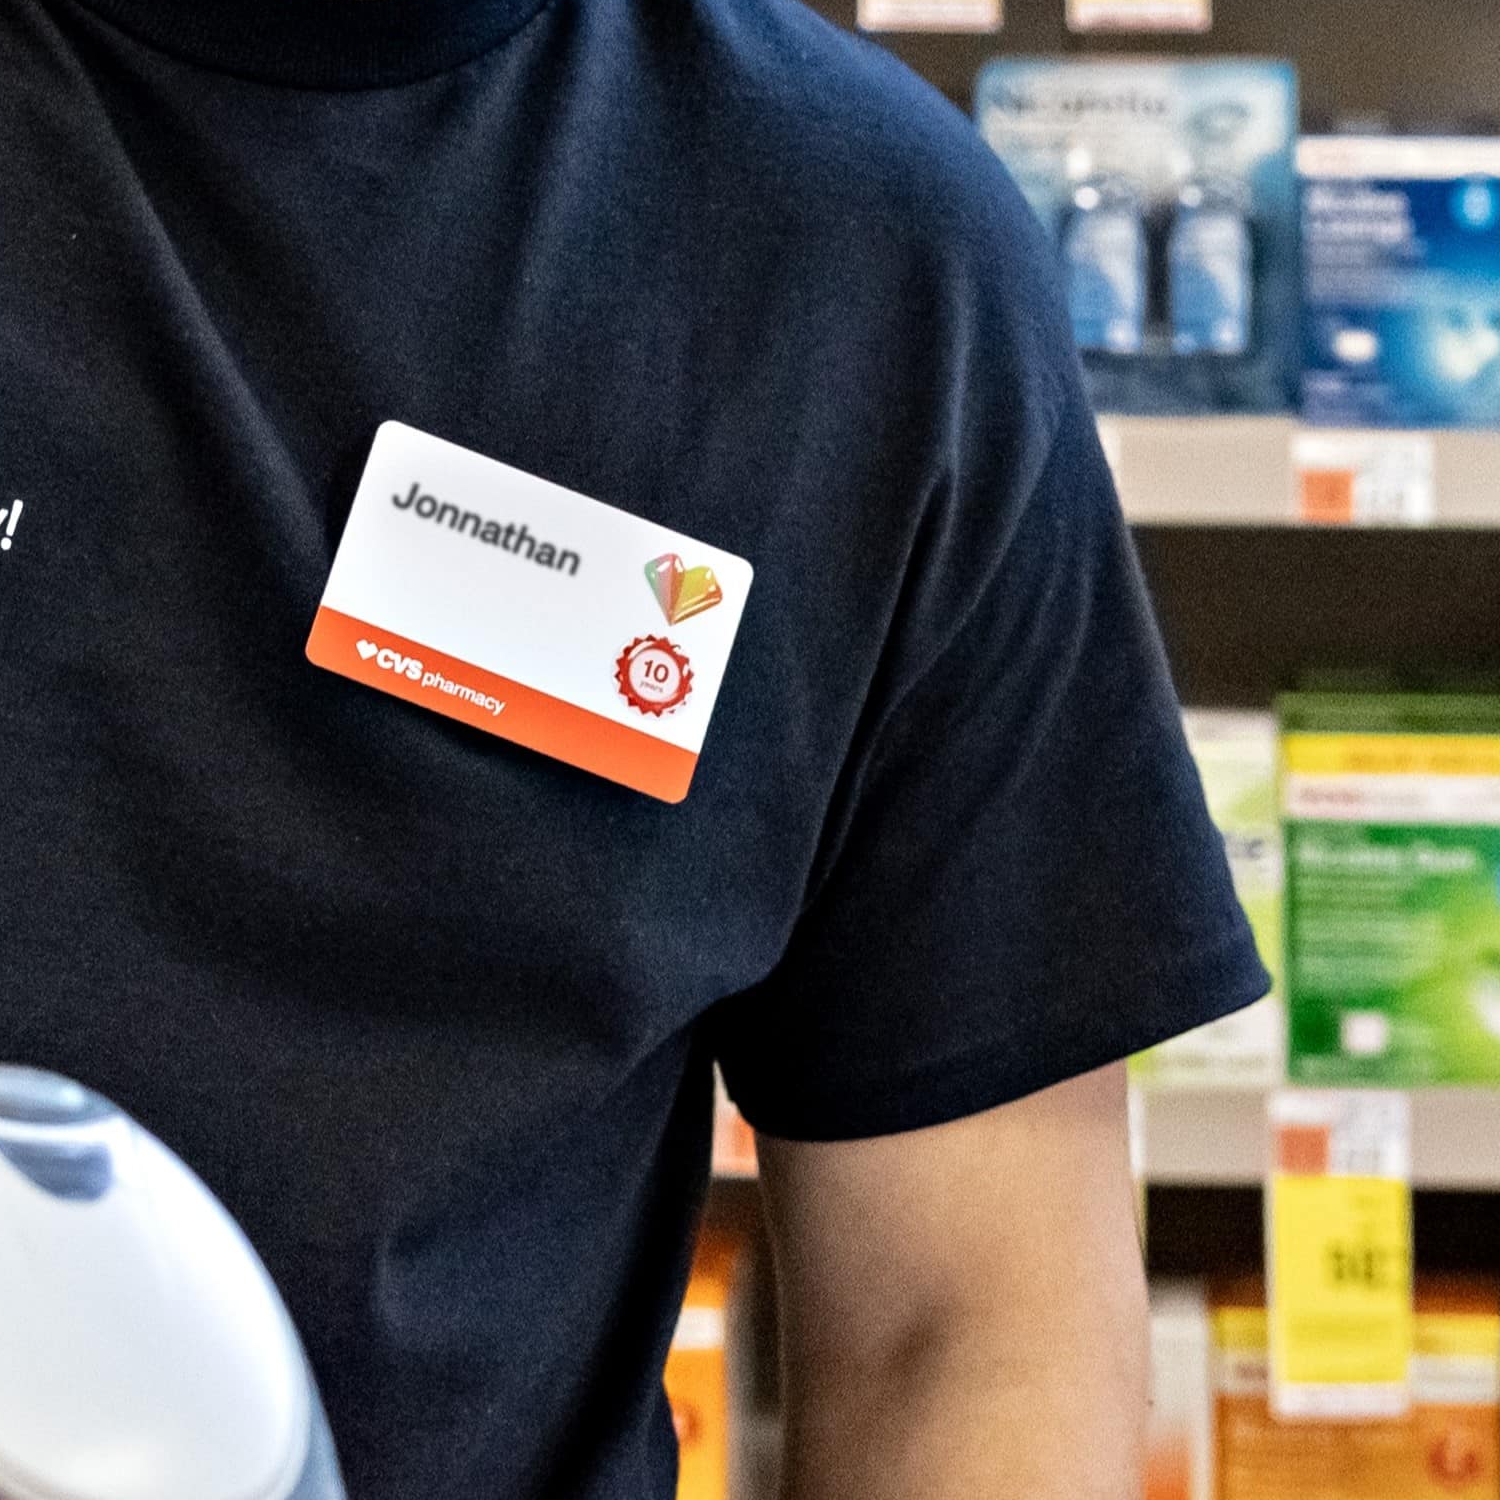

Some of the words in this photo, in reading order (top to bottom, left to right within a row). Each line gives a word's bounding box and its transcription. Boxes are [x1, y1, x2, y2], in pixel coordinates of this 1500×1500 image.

[392, 482, 582, 576] Jonnathan
[376, 648, 424, 681] CVS
[421, 671, 506, 716] pharmacy
[644, 660, 669, 683] 10
